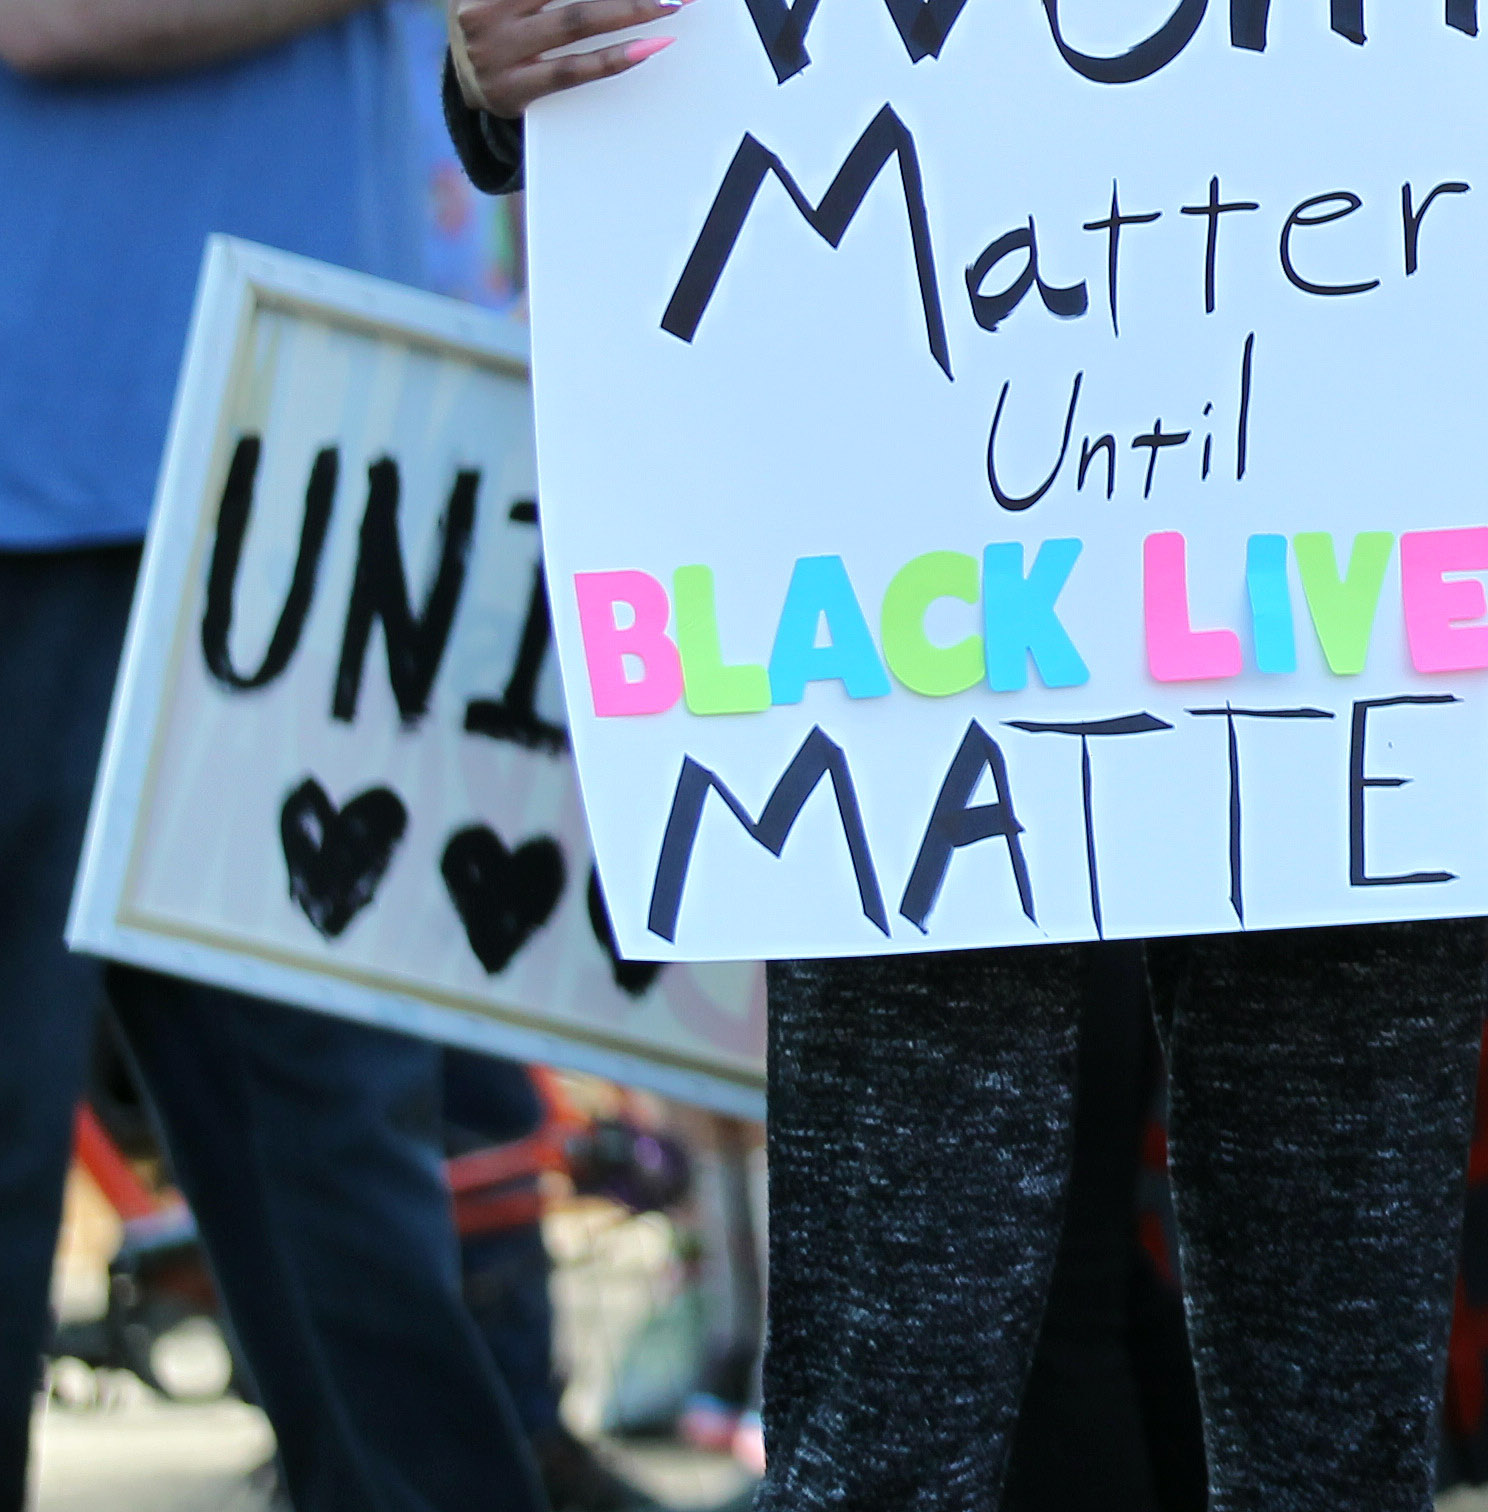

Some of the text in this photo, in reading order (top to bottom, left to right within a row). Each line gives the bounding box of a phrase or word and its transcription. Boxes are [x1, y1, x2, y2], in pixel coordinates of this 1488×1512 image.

[659, 101, 1470, 382] Matter
[985, 332, 1255, 512] Until
[574, 536, 1091, 718] BLACK
